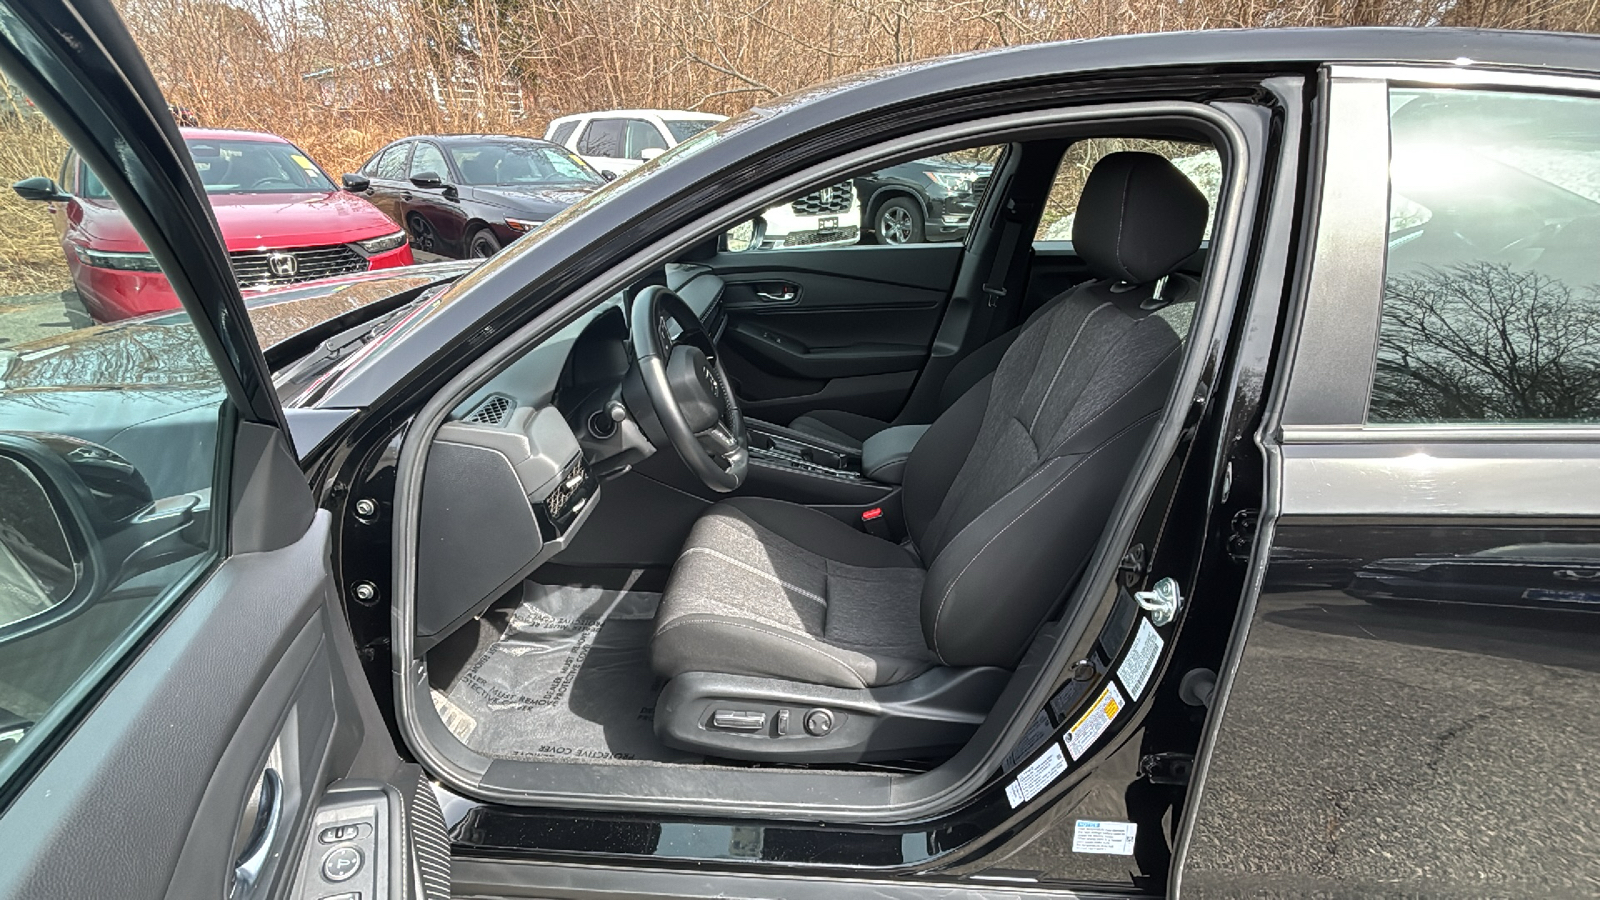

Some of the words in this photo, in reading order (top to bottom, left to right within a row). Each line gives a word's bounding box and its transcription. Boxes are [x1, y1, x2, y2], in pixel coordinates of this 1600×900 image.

[461, 676, 501, 704] OTECTIVE
[519, 695, 559, 707] REMOVE
[538, 744, 573, 756] COVER
[576, 749, 635, 760] PROTECTIVE
